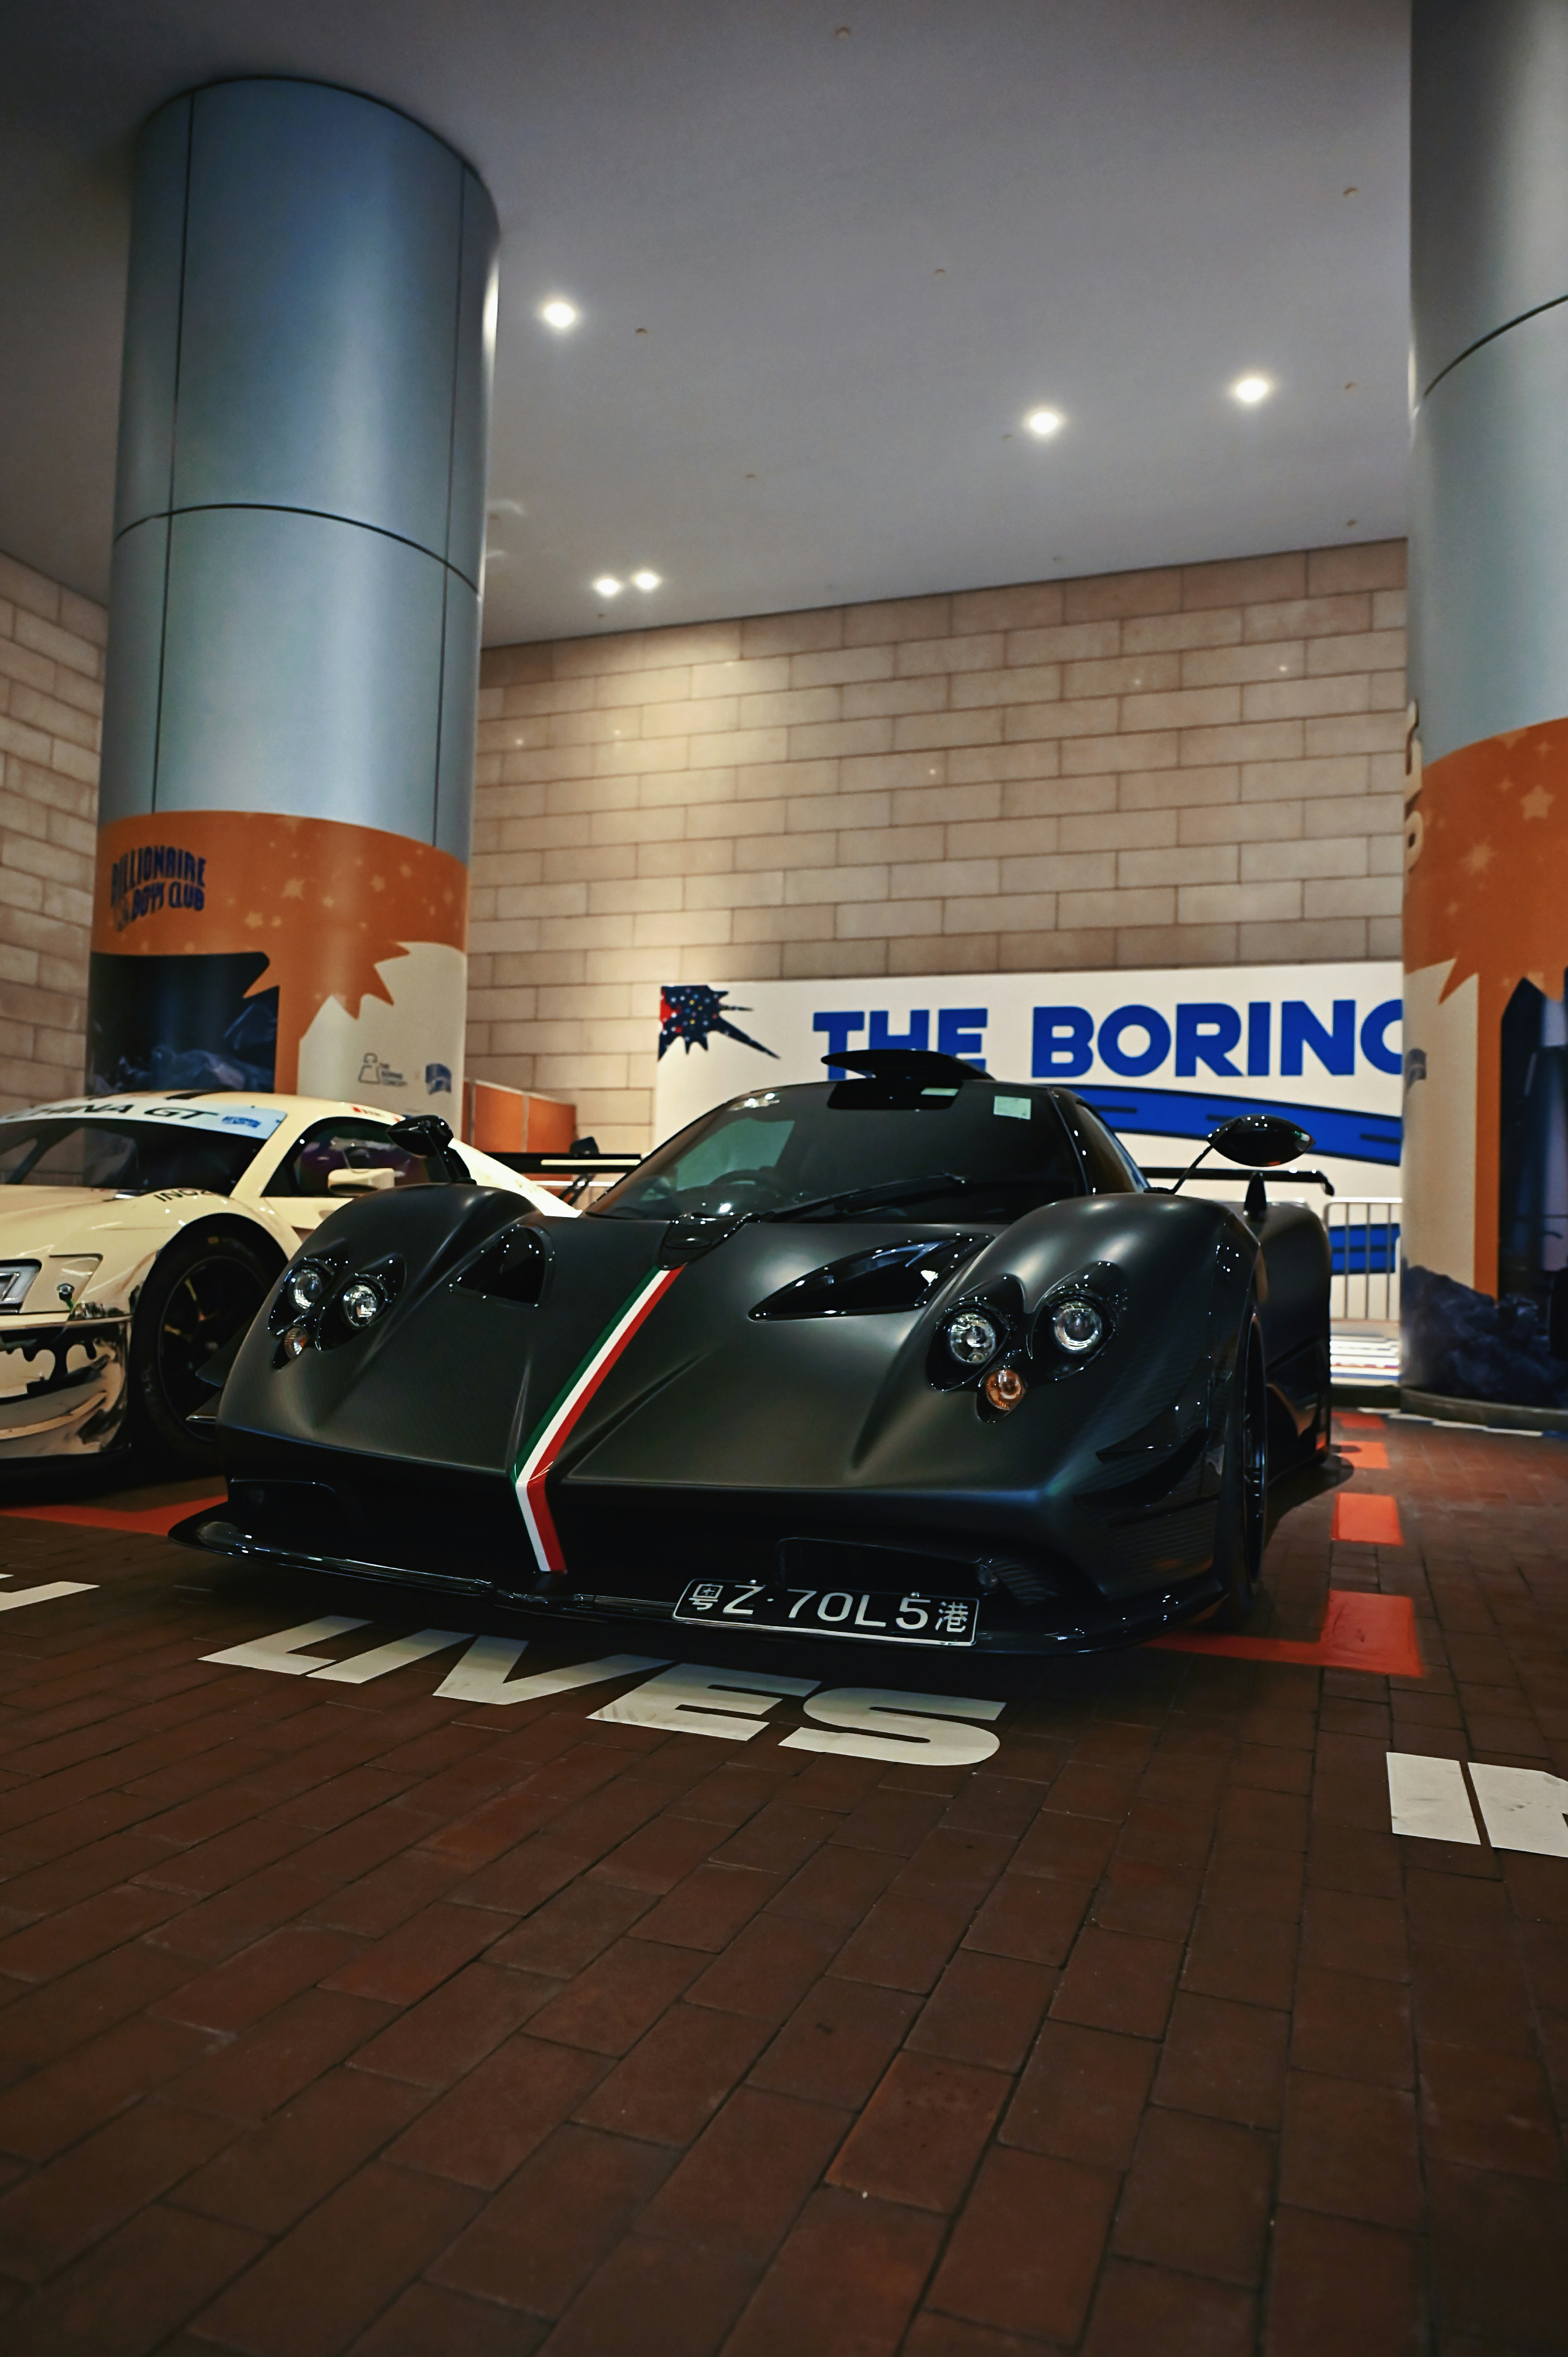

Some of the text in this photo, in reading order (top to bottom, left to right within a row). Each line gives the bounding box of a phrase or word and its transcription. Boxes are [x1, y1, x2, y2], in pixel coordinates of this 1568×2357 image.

[168, 881, 205, 911] CLUB
[813, 1008, 988, 1079] THE
[144, 1106, 219, 1119] GT
[197, 1614, 1007, 1766] LIVES
